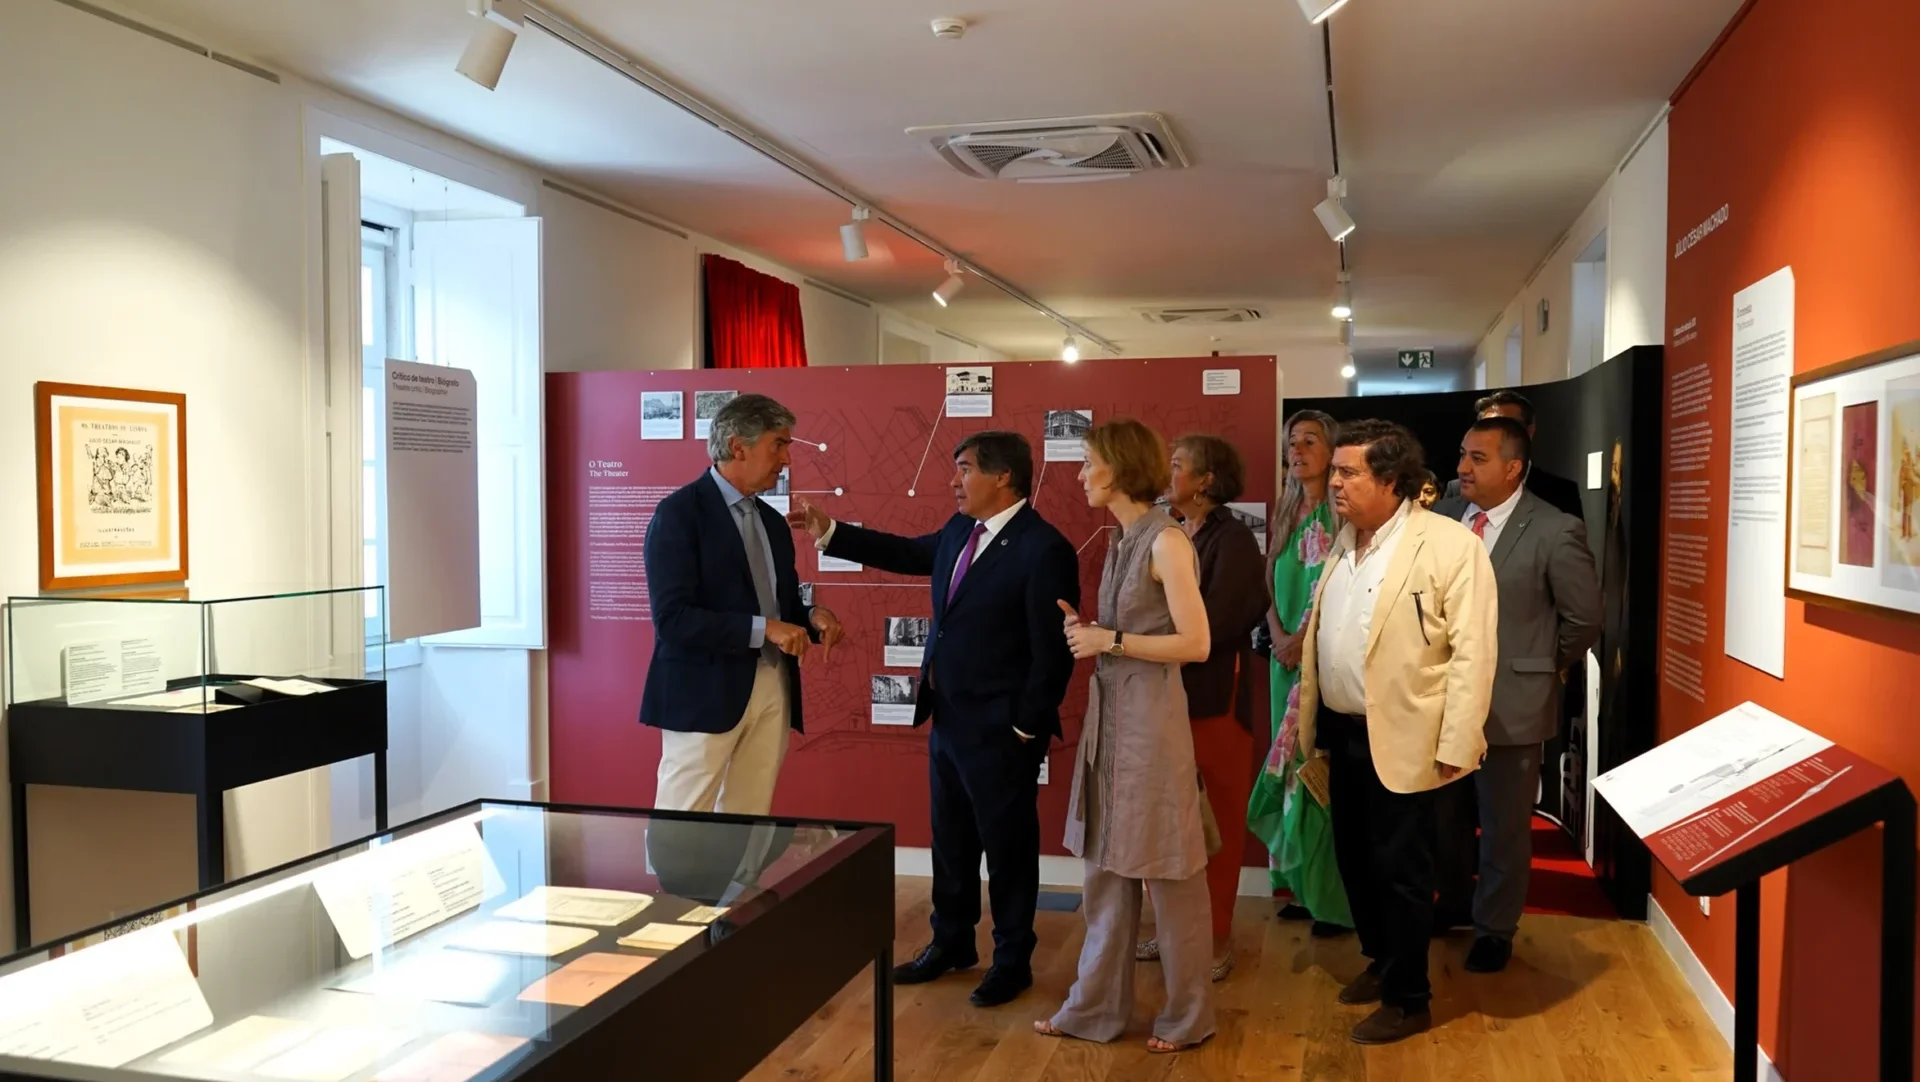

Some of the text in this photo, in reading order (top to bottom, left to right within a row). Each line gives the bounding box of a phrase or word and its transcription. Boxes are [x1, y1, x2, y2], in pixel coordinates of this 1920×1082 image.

[411, 374, 418, 383] de
[588, 460, 623, 468] O Teatro
